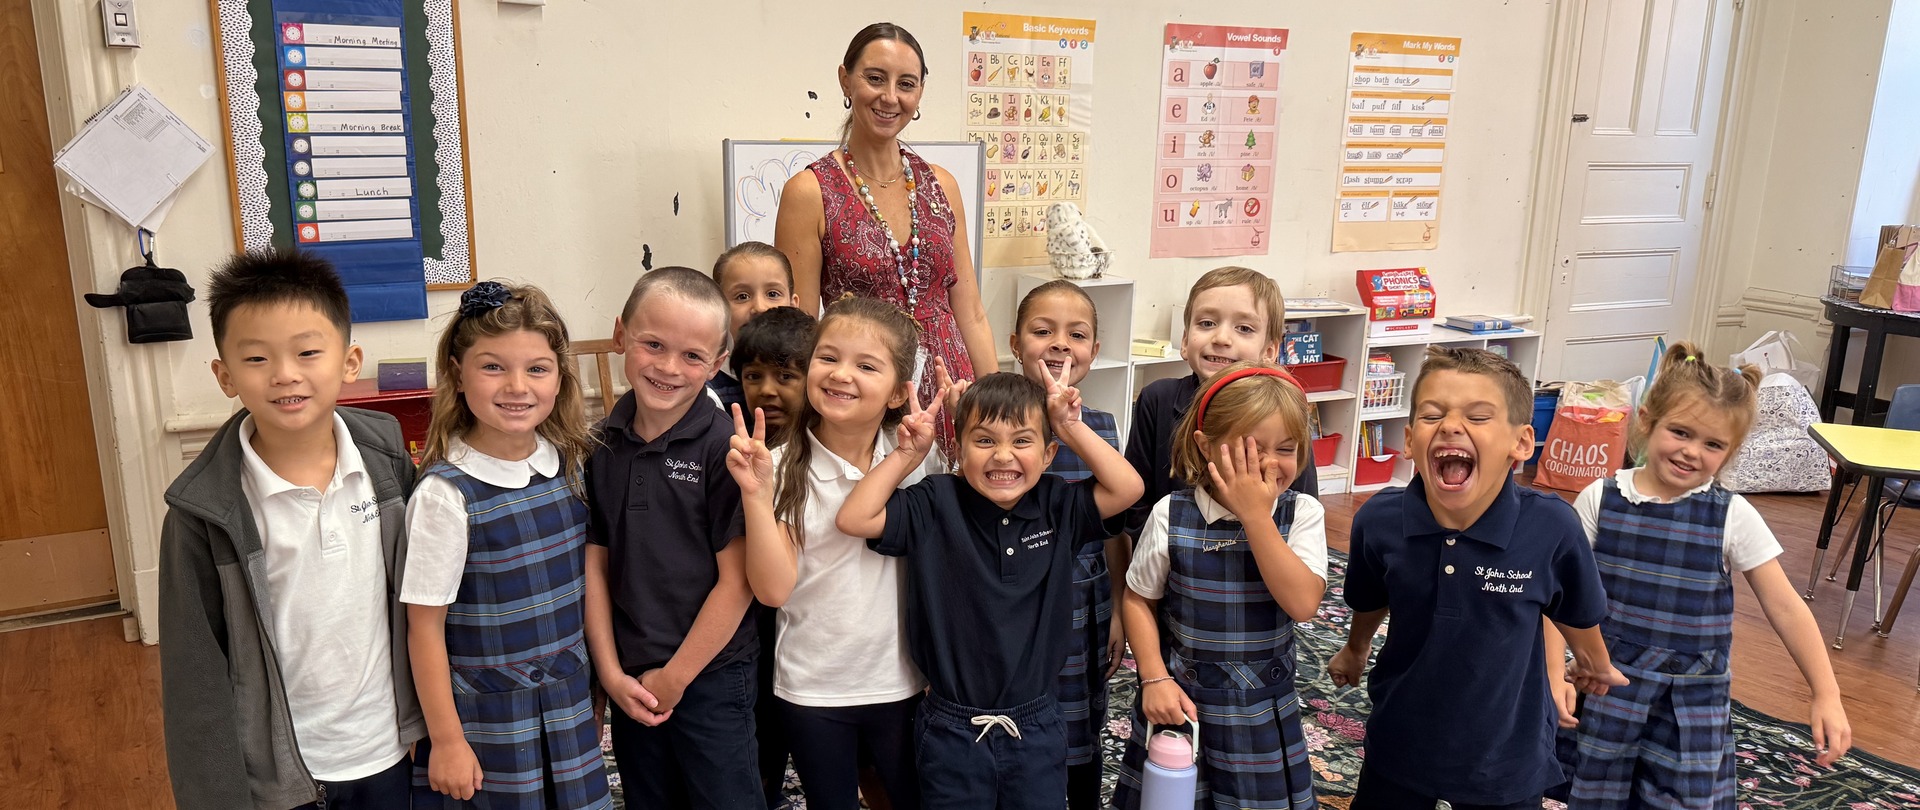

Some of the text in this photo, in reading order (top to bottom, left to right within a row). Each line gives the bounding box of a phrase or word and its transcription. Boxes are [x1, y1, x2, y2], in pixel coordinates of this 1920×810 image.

[1023, 23, 1089, 36] Basic Keywords
[334, 36, 398, 47] Morning Meeting
[1227, 32, 1281, 43] Vowel Sounds
[1403, 41, 1455, 51] Mark My Words
[972, 53, 1067, 67] Aa Bb Cc Dd Ee Ff
[1173, 68, 1184, 83] a
[1354, 76, 1411, 85] shop bath duck
[970, 93, 982, 106] Gg
[989, 94, 999, 104] Hh
[1024, 95, 1032, 107] Jj
[1040, 96, 1049, 105] Kk
[1172, 103, 1182, 118] e
[340, 124, 375, 133] Morning
[968, 132, 982, 142] Mm
[988, 133, 998, 142] Nn
[1004, 133, 1016, 142] Oo
[1022, 133, 1031, 145] Pp
[1056, 134, 1064, 142] Rr
[1072, 134, 1080, 142] Ss
[1170, 136, 1177, 154] i
[987, 170, 1079, 182] Uu Vv Ww Xx Yy Zz
[1166, 174, 1178, 188] o
[355, 187, 388, 196] Lunch
[987, 207, 1043, 217] ch sh th ck
[1163, 209, 1175, 222] u
[1383, 277, 1418, 285] PHONICS
[1303, 334, 1319, 343] CAT
[1303, 355, 1320, 363] HAT
[1550, 438, 1608, 465] CHAOS
[673, 460, 688, 470] John
[1545, 459, 1608, 478] COORDINATOR
[668, 471, 699, 483] North End
[1039, 528, 1053, 537] School
[1028, 542, 1039, 550] North
[1202, 539, 1237, 553] Margherita
[1475, 566, 1532, 580] St John School
[1482, 582, 1523, 593] North End
